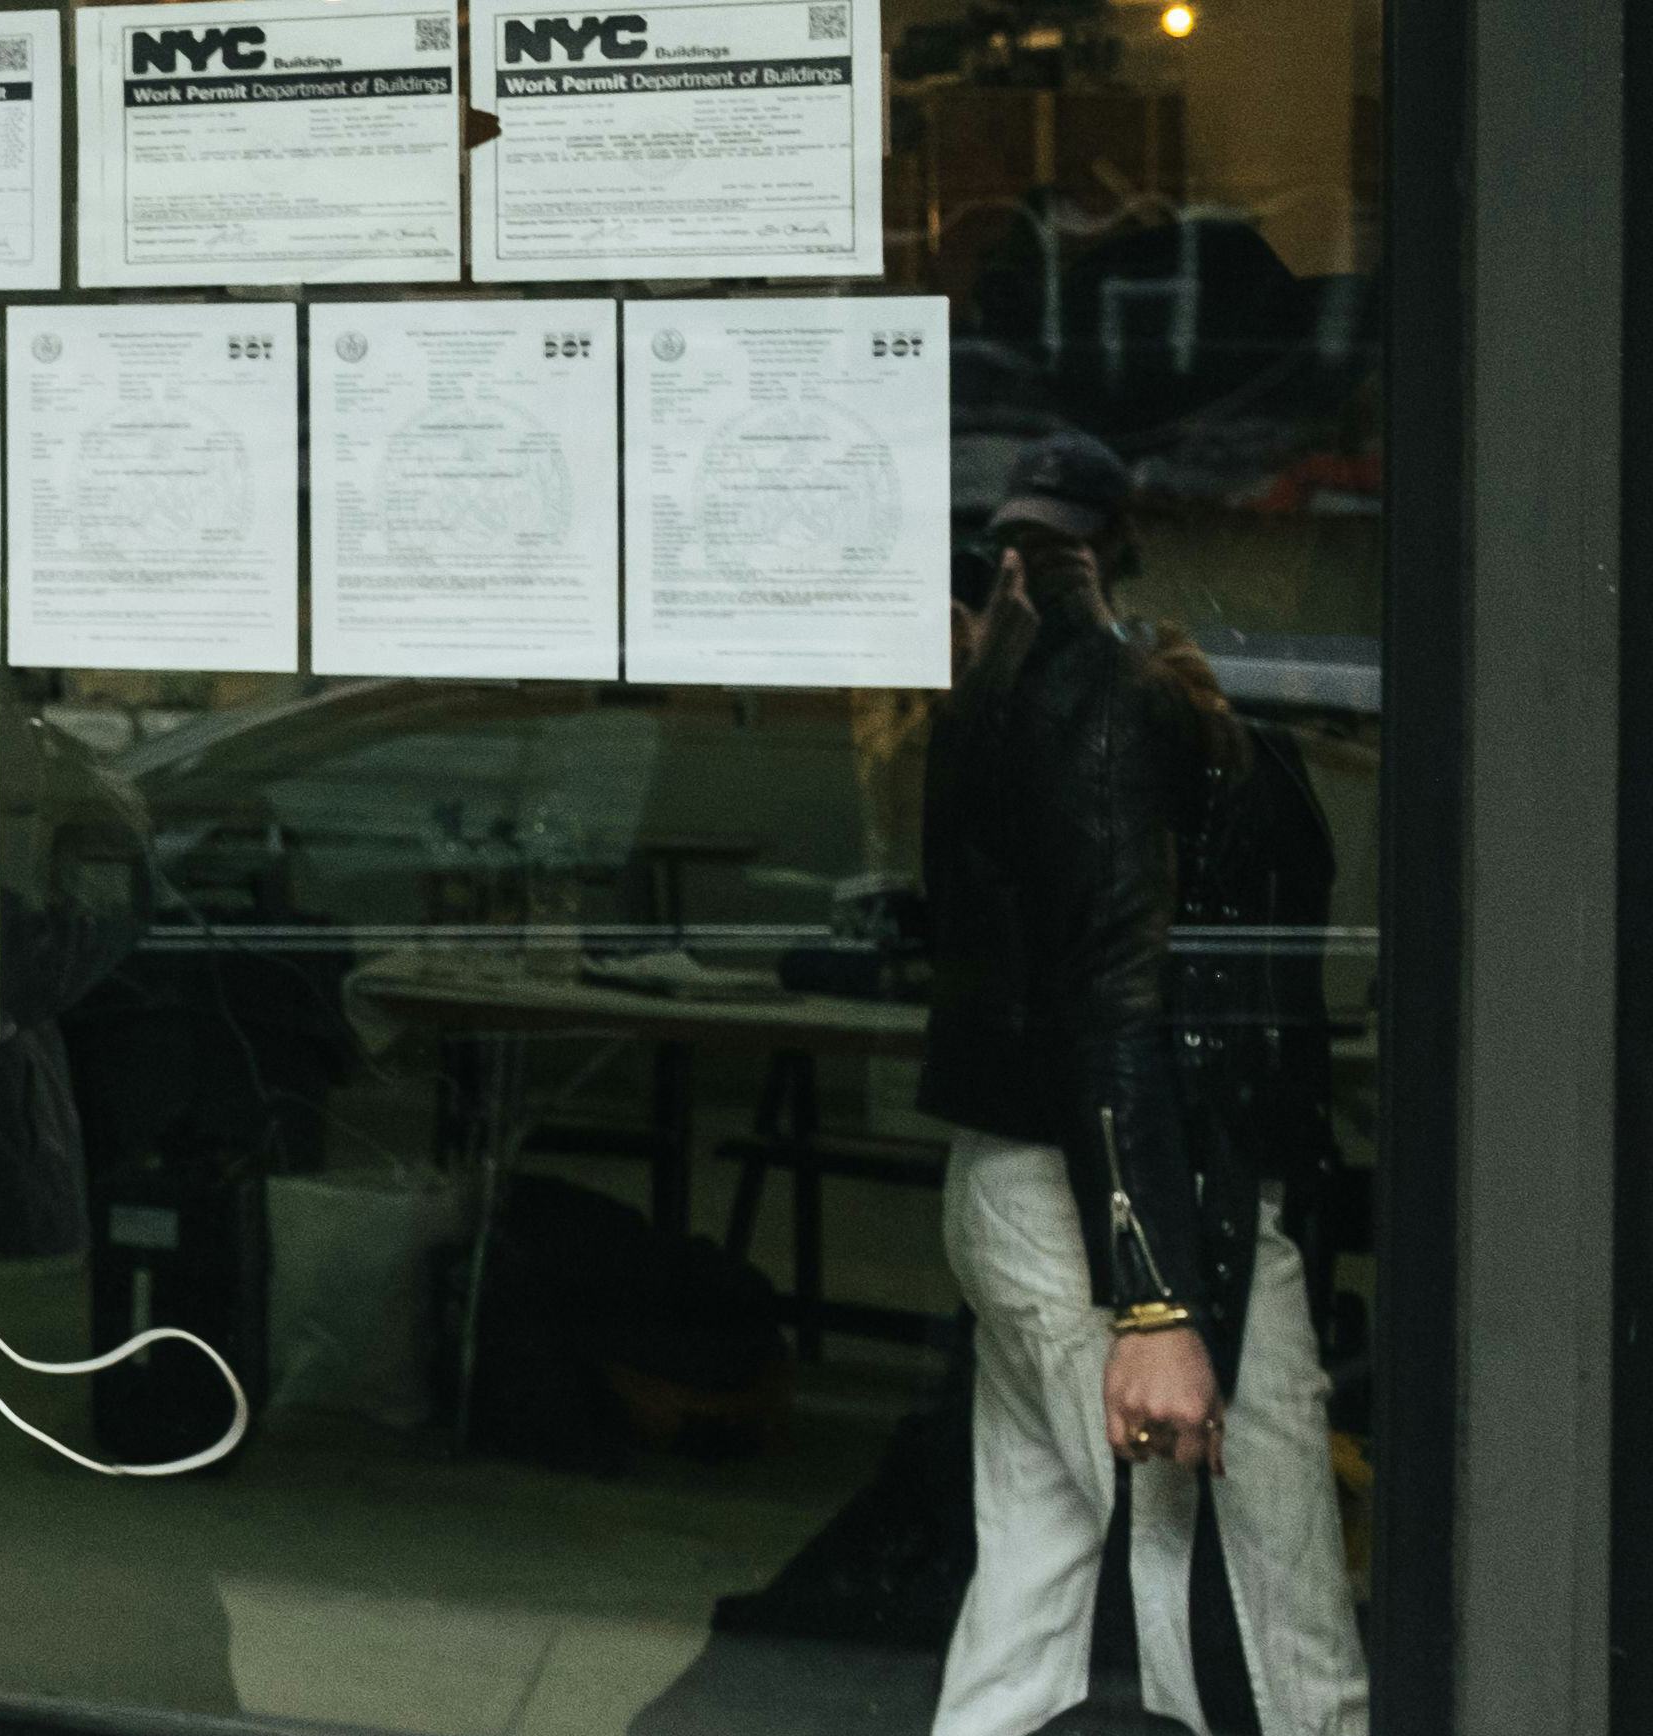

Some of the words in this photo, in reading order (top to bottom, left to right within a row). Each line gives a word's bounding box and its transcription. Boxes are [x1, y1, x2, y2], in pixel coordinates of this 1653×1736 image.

[132, 26, 267, 74] NYC
[504, 14, 648, 63] NYC
[655, 45, 730, 59] Buildings
[273, 56, 342, 71] Buildings
[133, 85, 182, 103] Work
[186, 83, 247, 101] Permit
[252, 81, 348, 100] Department
[350, 78, 370, 95] of
[373, 76, 448, 93] Buildings
[505, 76, 558, 94] Work
[561, 73, 629, 92] Permit
[632, 70, 735, 90] Department
[739, 68, 759, 85] of
[763, 66, 843, 85] Buildings
